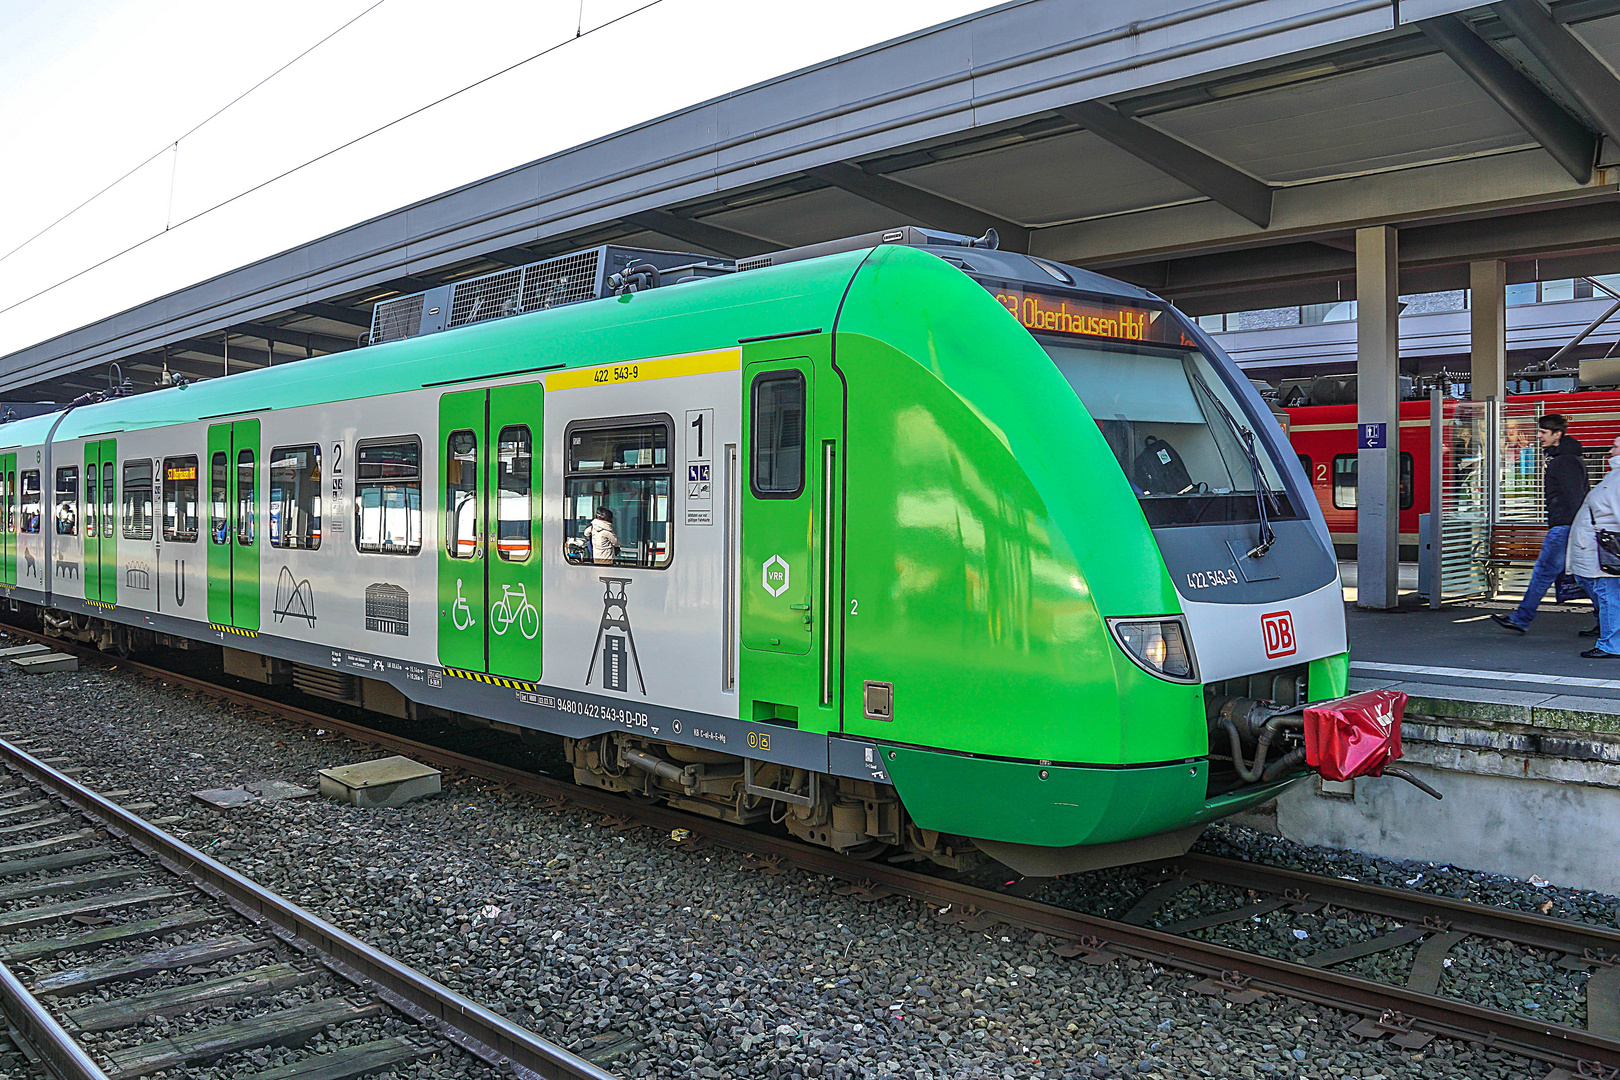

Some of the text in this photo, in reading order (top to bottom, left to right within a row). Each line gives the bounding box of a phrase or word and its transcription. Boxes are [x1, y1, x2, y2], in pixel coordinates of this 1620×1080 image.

[1023, 298, 1117, 338] Oberhausen
[1119, 311, 1144, 340] Hbf
[594, 365, 639, 383] 422 543-9
[691, 413, 703, 457] 1
[154, 459, 161, 482] 2
[332, 444, 342, 474] 2
[1316, 464, 1327, 481] 2
[768, 571, 784, 581] VRR
[1186, 569, 1238, 589] 422 543-9
[850, 599, 859, 615] 2
[1265, 618, 1292, 651] DB
[556, 697, 577, 715] 9480
[577, 702, 584, 716] 0
[584, 703, 600, 720] 422
[600, 707, 625, 724] 543-9
[625, 712, 649, 729] D-DB
